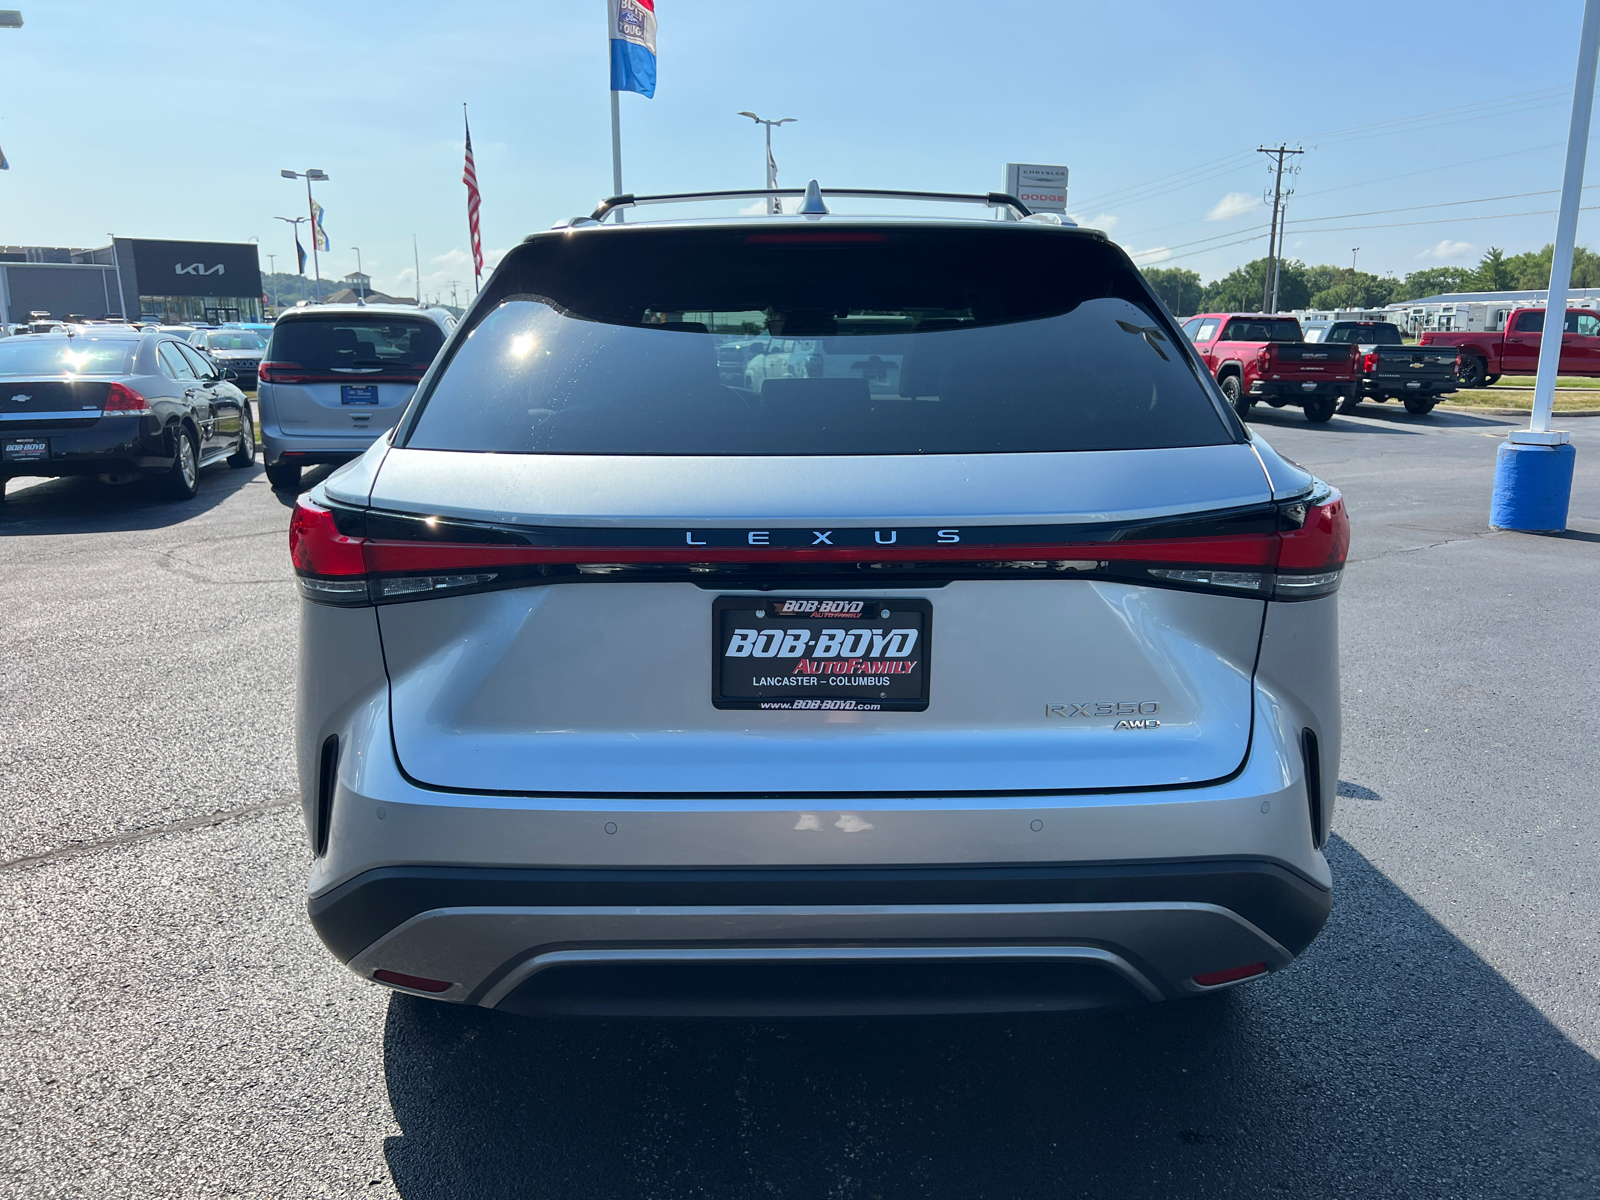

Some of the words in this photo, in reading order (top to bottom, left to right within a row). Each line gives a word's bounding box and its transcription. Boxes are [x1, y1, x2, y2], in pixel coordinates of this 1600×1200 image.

[619, 21, 644, 37] TOUG
[1021, 193, 1065, 202] DODGE
[175, 262, 225, 276] KIA
[686, 529, 960, 545] LEXUS
[725, 628, 919, 658] BOB-BOYD
[753, 677, 818, 686] LANCASTER
[829, 676, 890, 686] COLUMBUS
[1113, 719, 1161, 730] AWD
